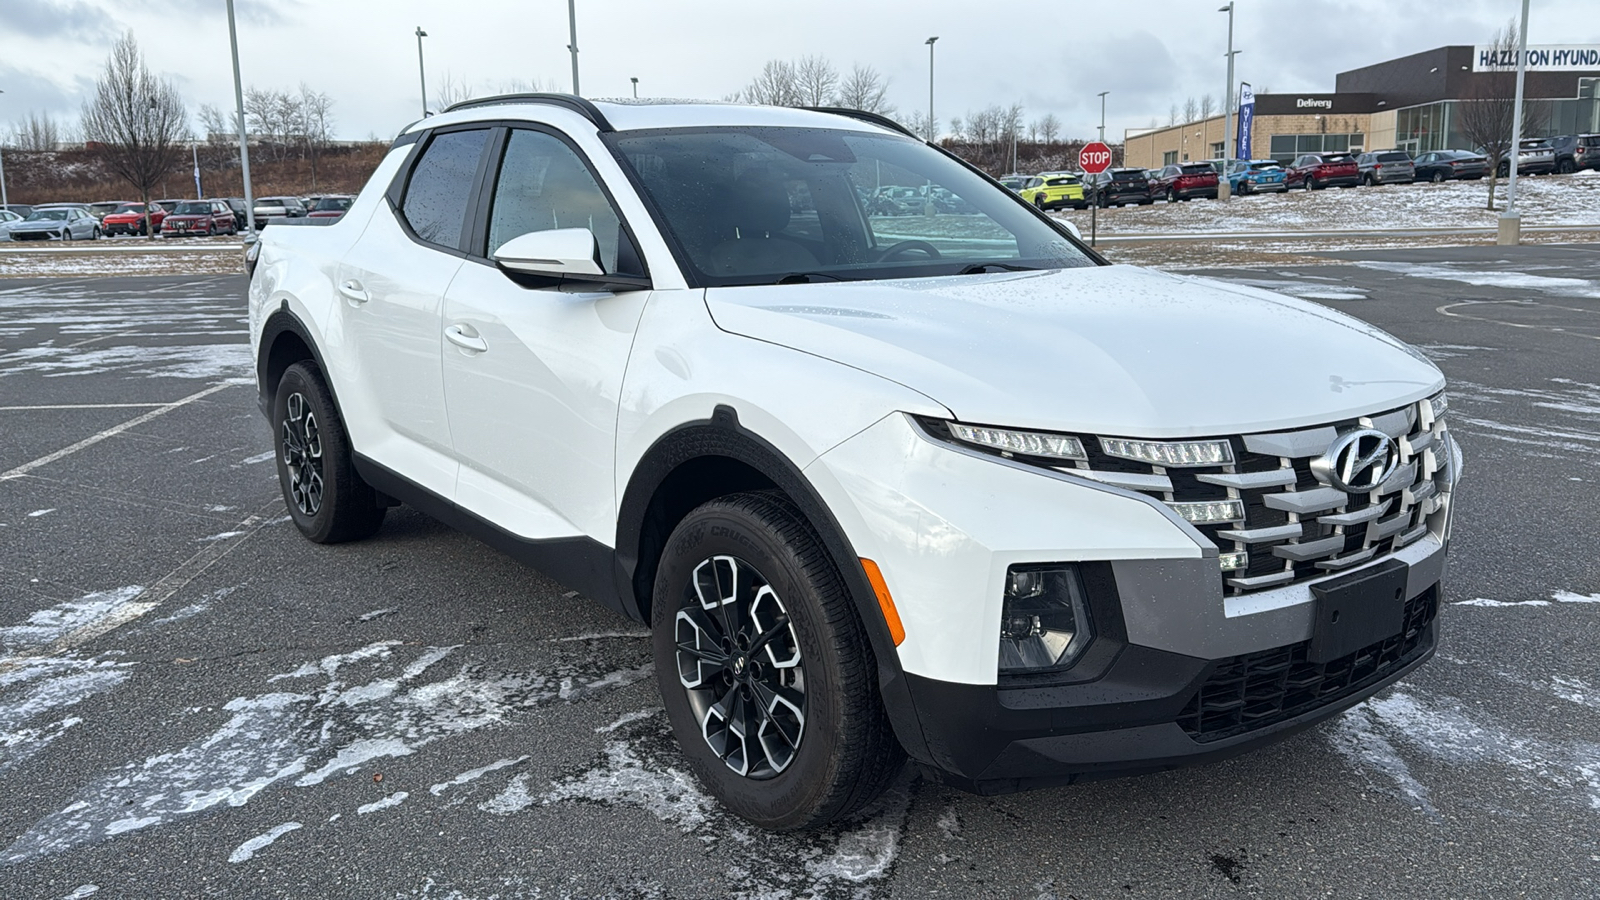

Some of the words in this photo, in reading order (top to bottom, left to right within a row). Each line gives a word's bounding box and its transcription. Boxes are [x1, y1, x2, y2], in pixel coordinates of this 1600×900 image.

[1480, 50, 1549, 66] HAZLTON
[1552, 50, 1600, 66] HYUND
[1296, 98, 1332, 109] Delivery
[1081, 151, 1110, 165] STOP
